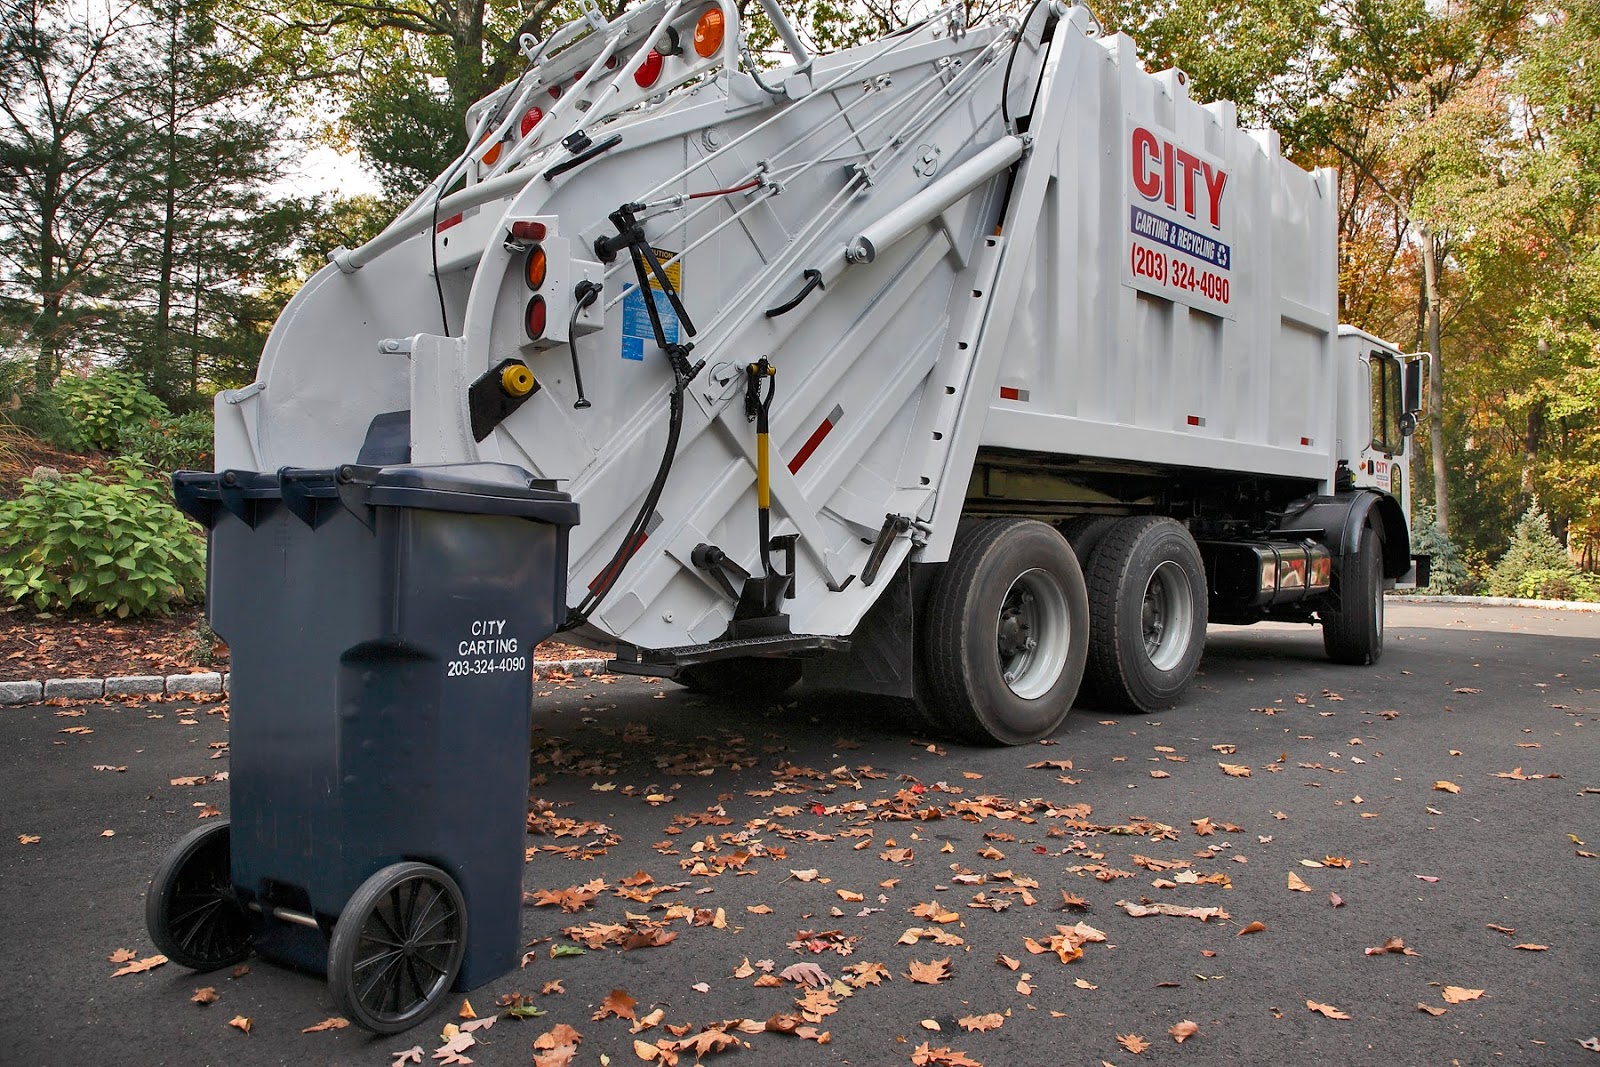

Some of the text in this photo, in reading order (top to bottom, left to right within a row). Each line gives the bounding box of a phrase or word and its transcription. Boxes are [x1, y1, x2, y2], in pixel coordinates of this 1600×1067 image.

[1132, 127, 1228, 229] CITY
[1135, 211, 1215, 260] CARTING & RECYCLING
[1131, 242, 1229, 304] (203) 324-4090
[1376, 461, 1388, 474] CITY
[471, 619, 506, 636] CITY
[458, 638, 518, 656] CARTING
[447, 656, 526, 677] 203-324-4090
